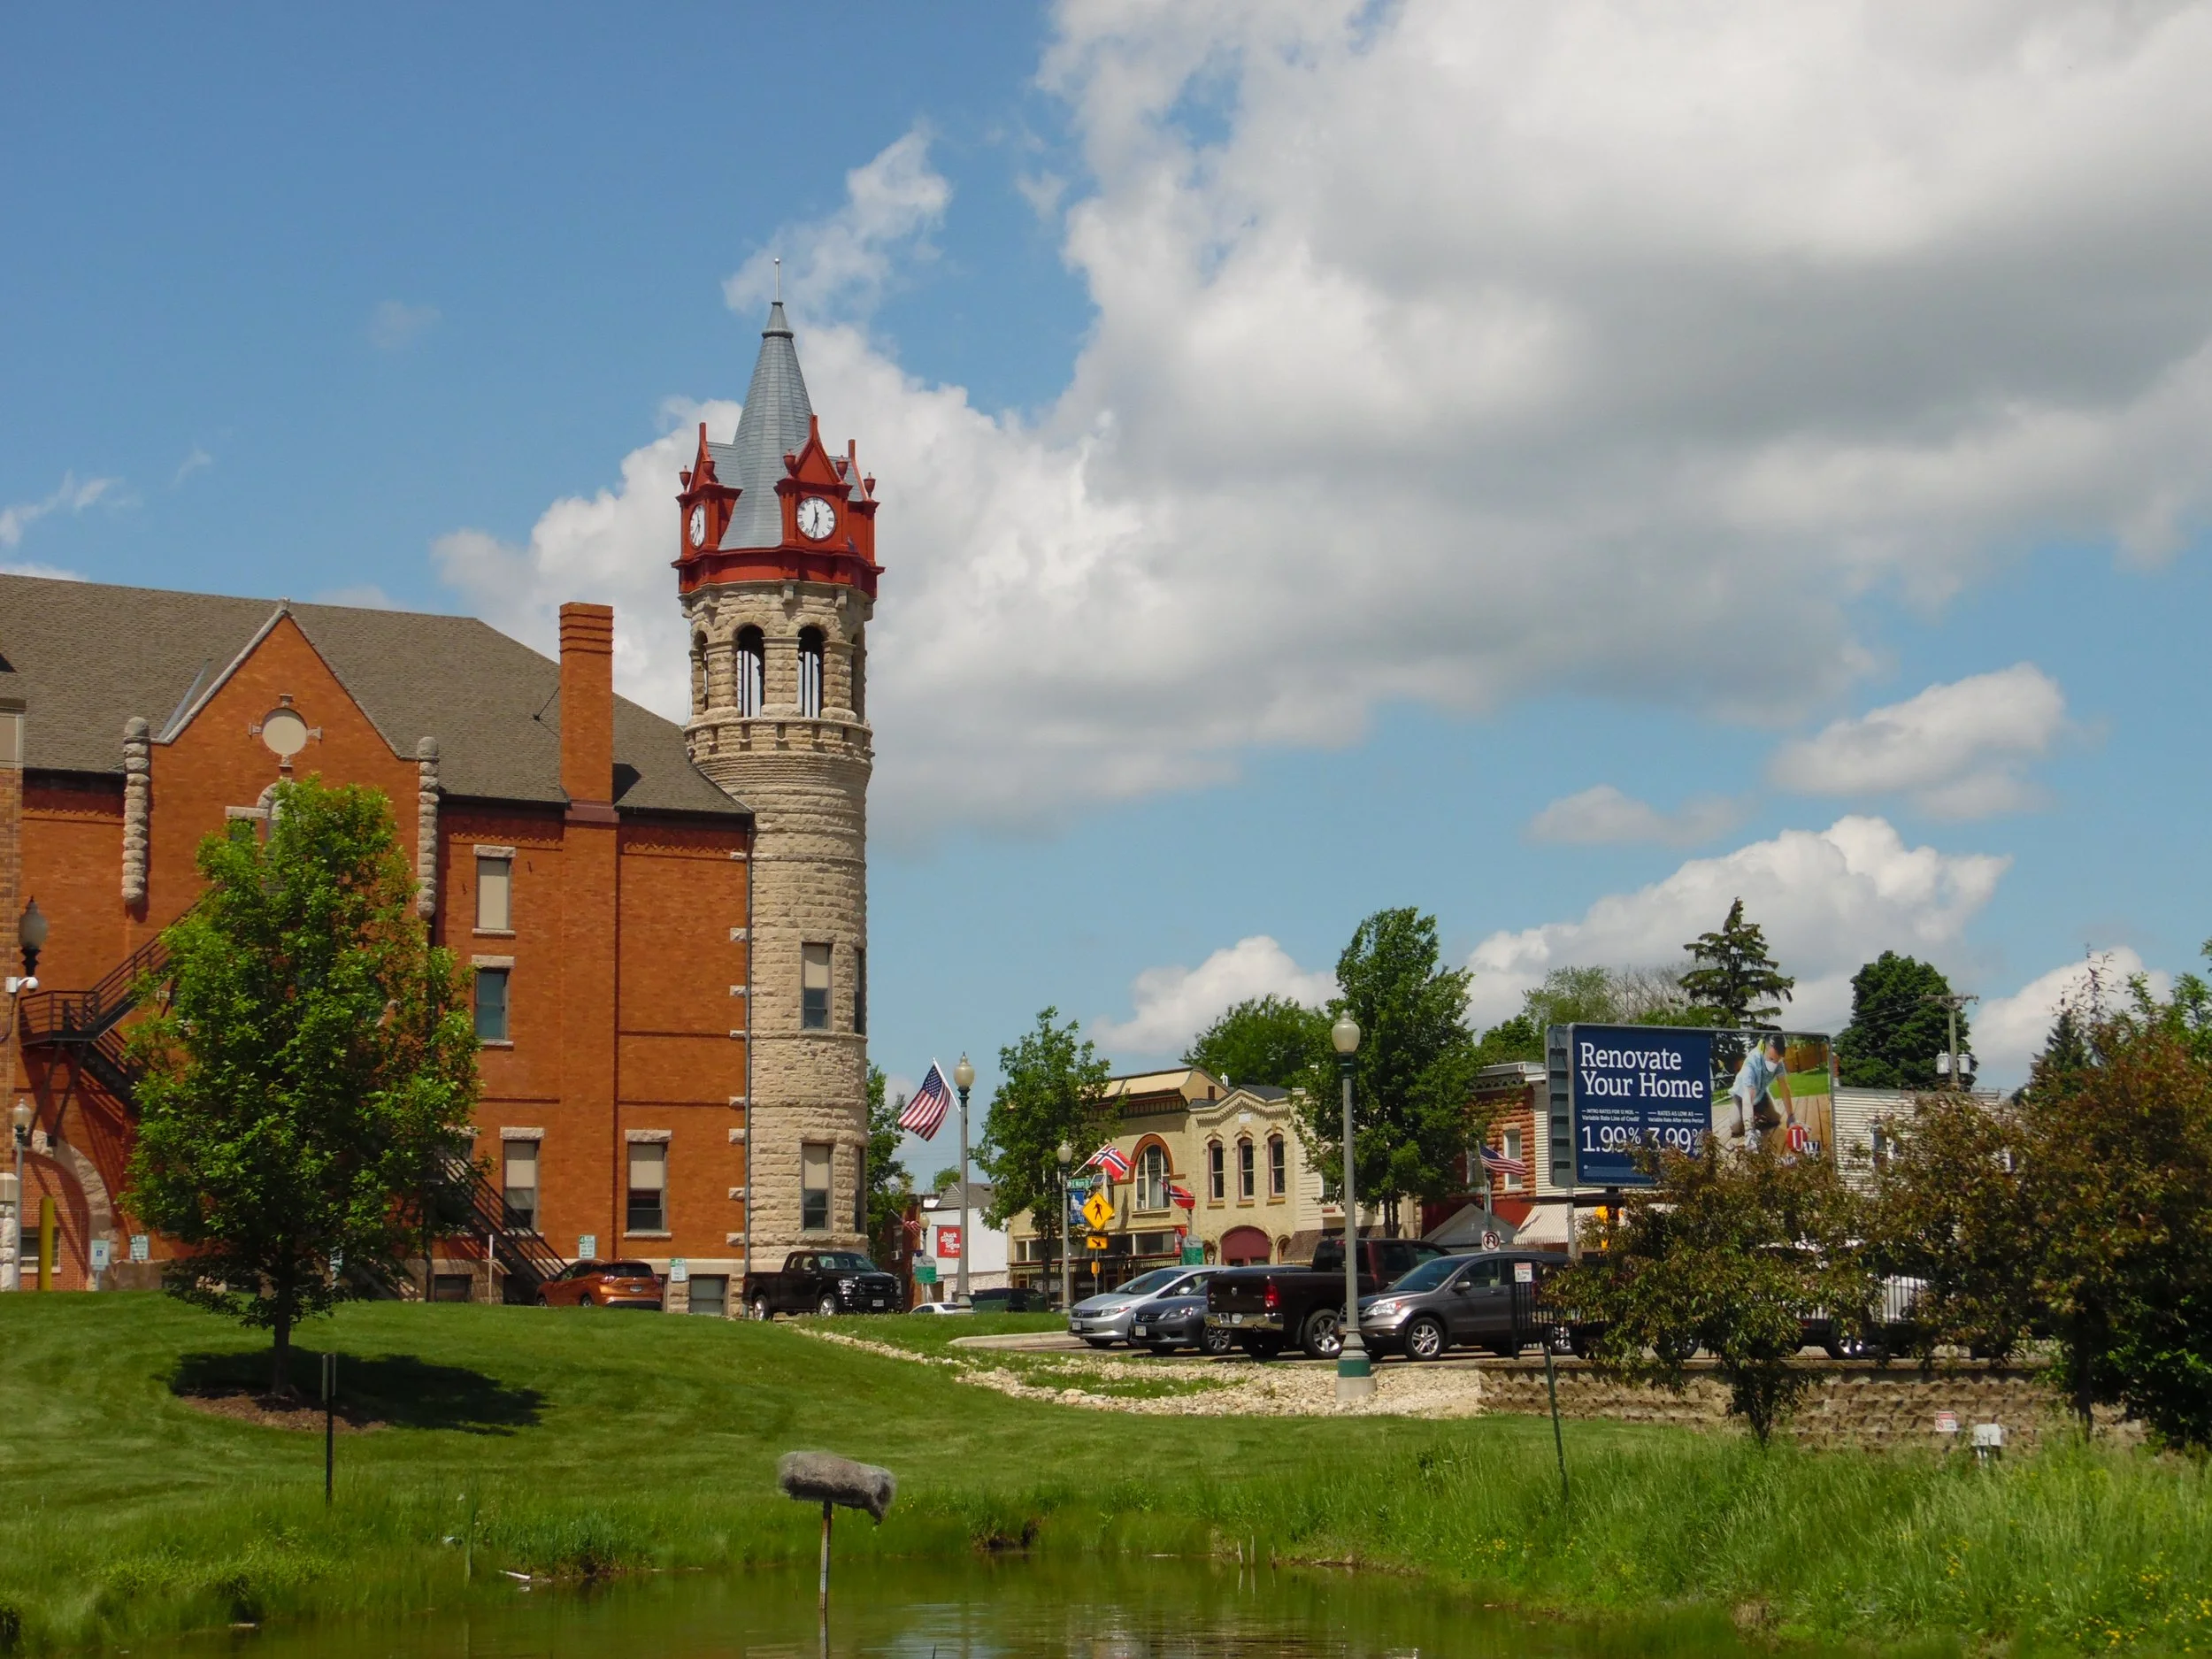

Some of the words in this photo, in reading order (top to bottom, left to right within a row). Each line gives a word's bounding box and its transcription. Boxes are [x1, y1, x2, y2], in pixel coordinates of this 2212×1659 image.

[1579, 1042, 1682, 1071] Renovate
[1580, 1071, 1633, 1096] Your
[1639, 1072, 1704, 1099] Home
[1582, 1125, 1641, 1152] 1.99%
